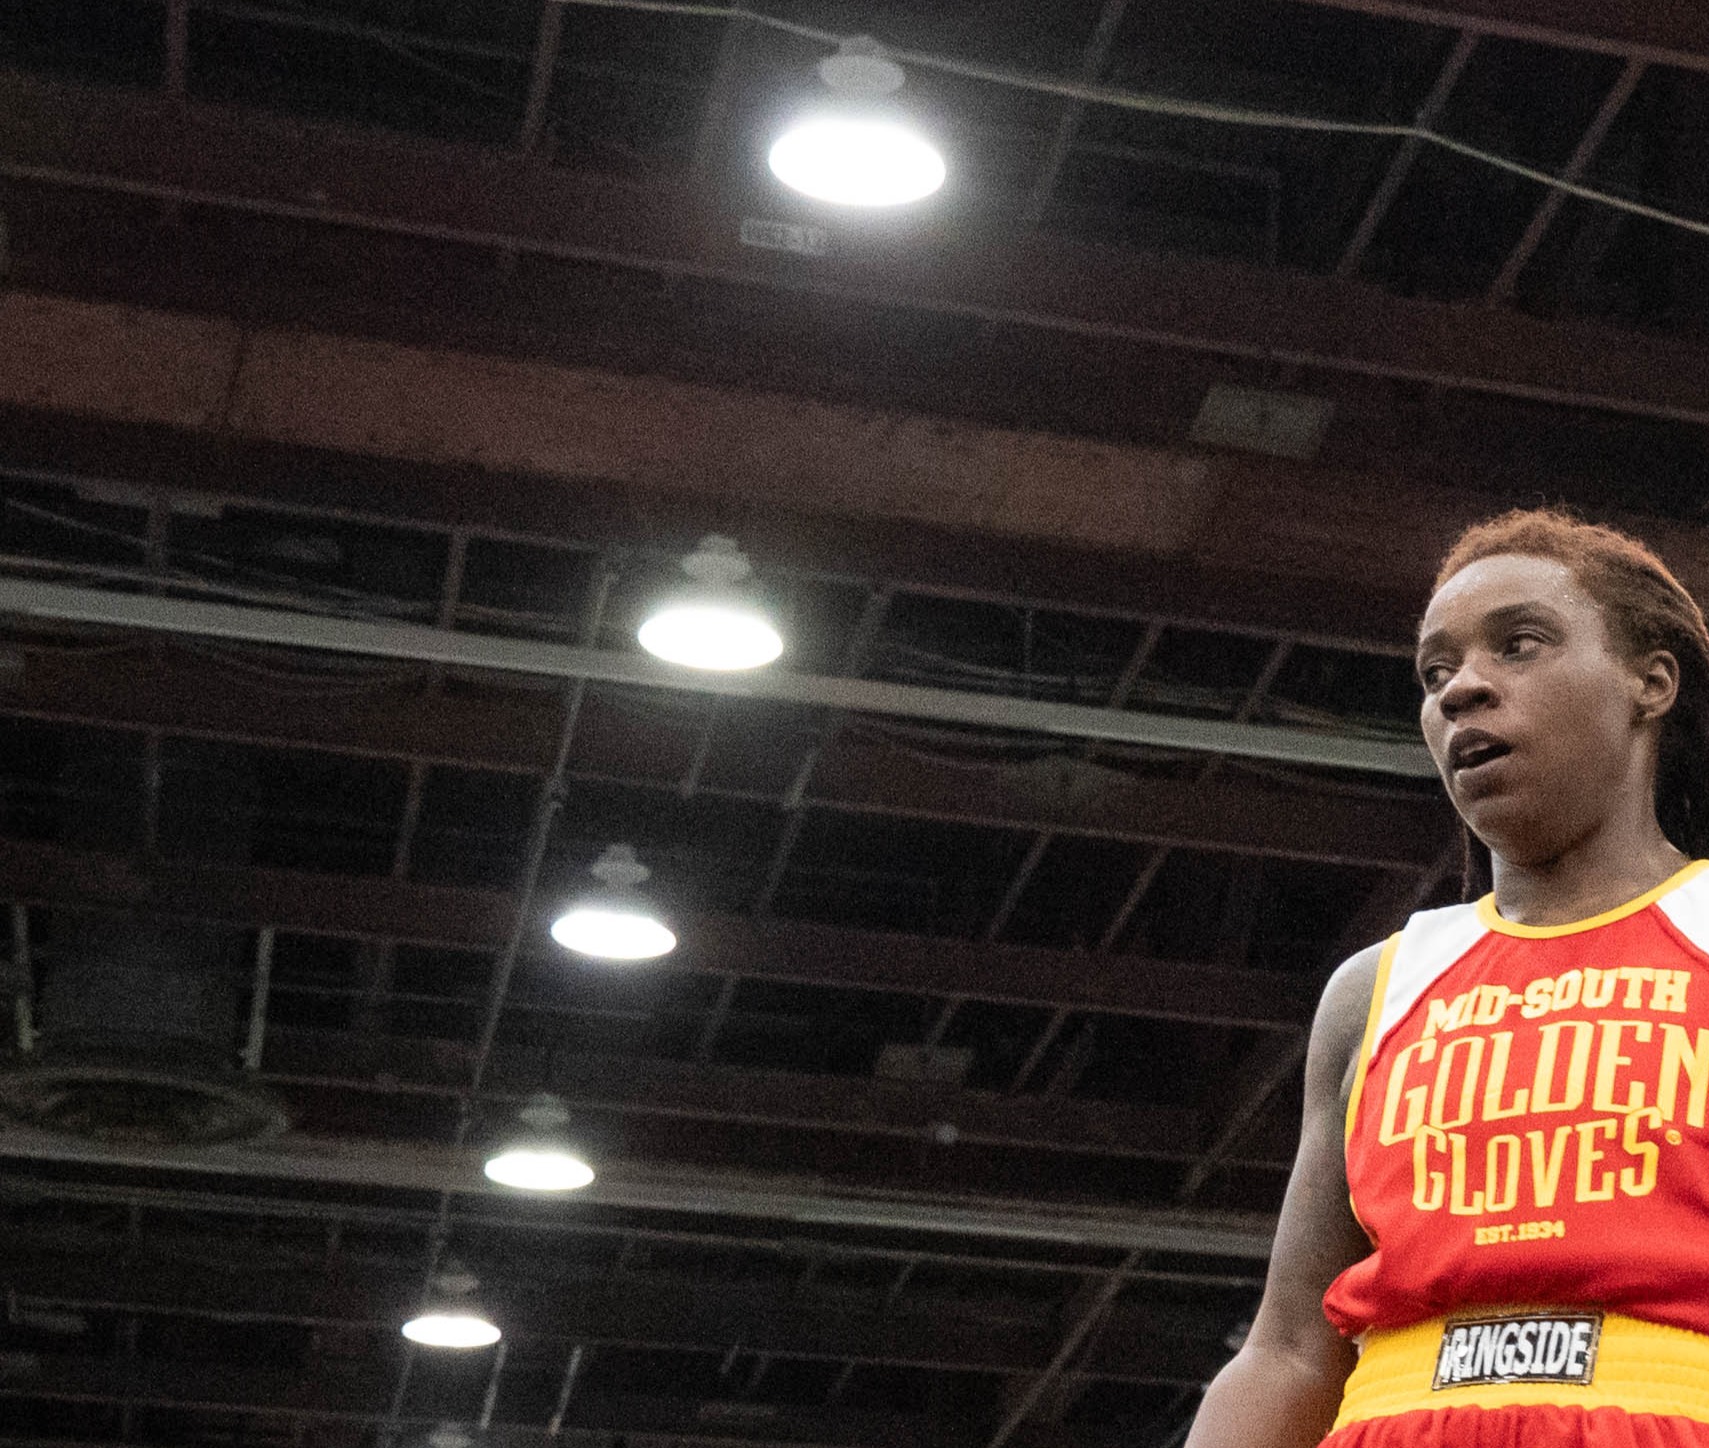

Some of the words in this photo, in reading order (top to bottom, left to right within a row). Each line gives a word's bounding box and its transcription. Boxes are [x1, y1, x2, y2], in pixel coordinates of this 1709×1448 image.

[1422, 966, 1690, 1038] MID-SOUTH
[1411, 1106, 1664, 1216] GLOVES
[1441, 1320, 1593, 1380] RINGSIDE
